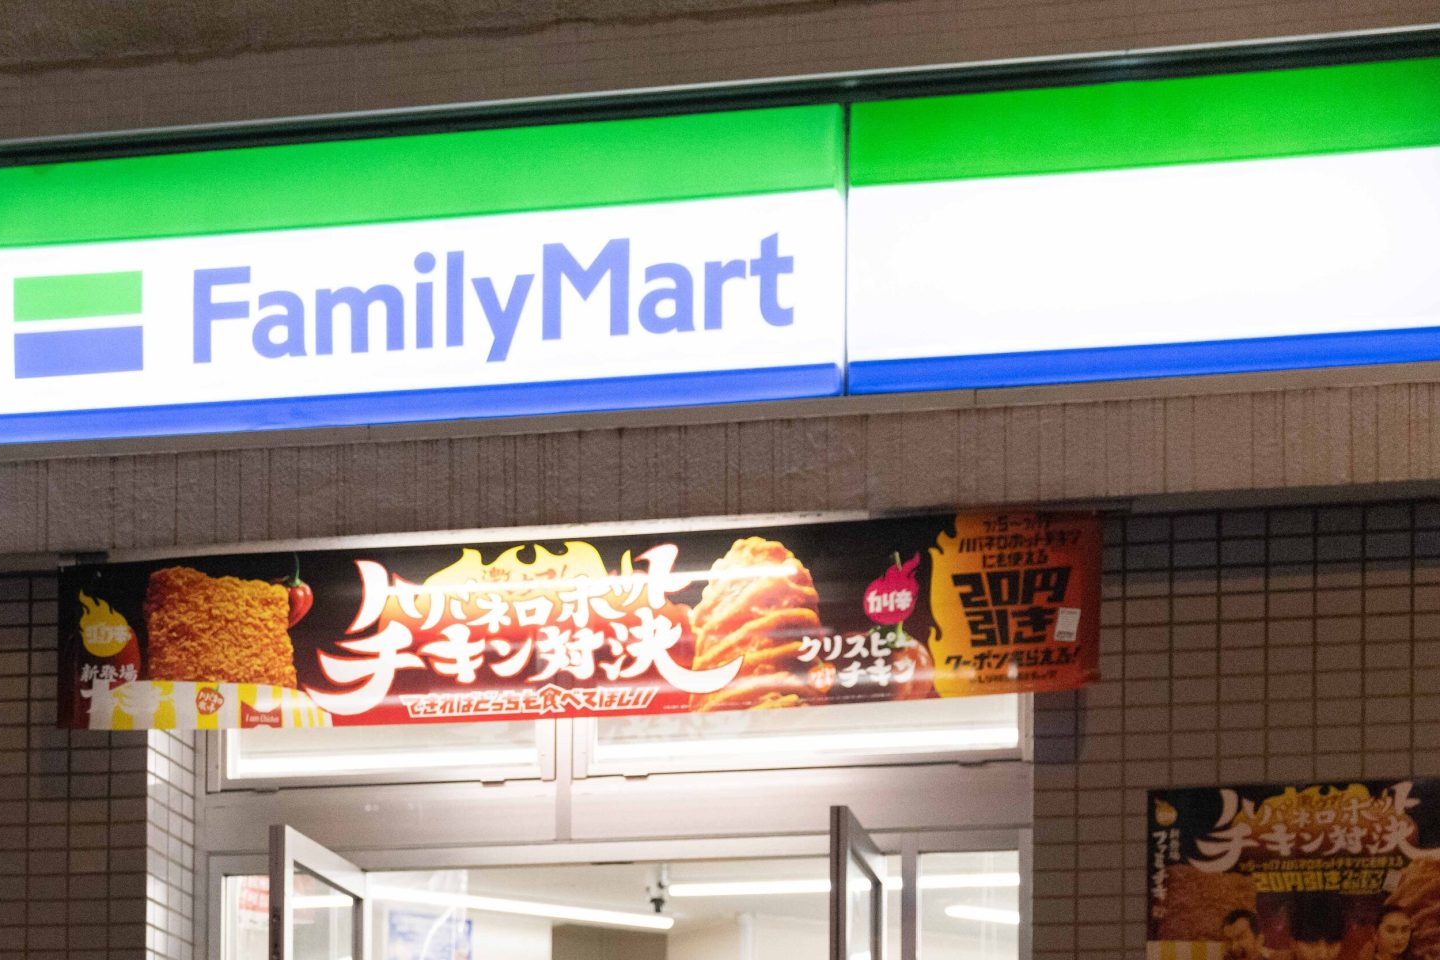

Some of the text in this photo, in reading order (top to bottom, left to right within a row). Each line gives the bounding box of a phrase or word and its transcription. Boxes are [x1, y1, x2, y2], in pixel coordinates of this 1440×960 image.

[192, 230, 796, 364] FamilyMart
[951, 566, 1072, 608] 20円
[797, 634, 919, 662] クリスピー
[964, 606, 1058, 648] 引き
[306, 607, 744, 715] チキン対決
[838, 658, 917, 688] チキン
